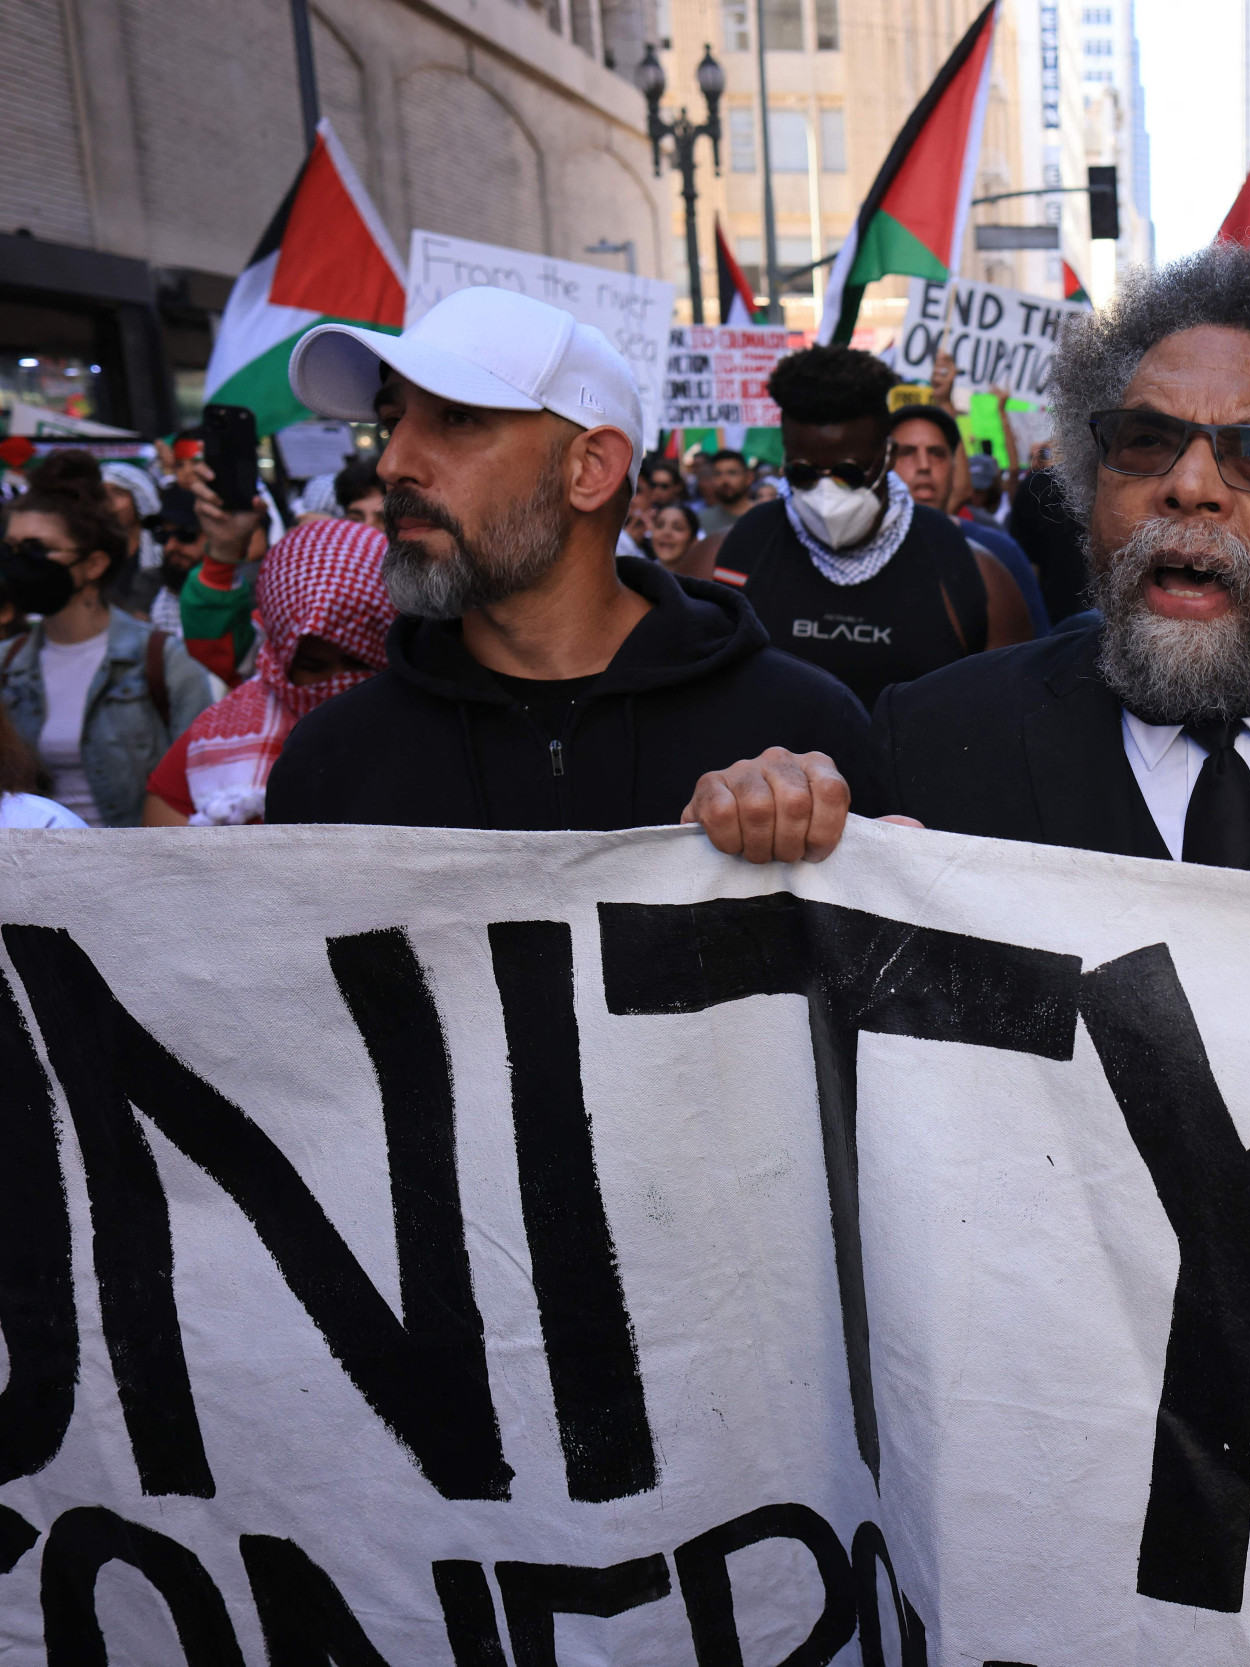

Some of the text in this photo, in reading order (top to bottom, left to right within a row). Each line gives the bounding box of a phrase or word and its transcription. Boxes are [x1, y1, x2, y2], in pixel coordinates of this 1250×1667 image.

[422, 237, 527, 294] From
[538, 262, 581, 303] the
[921, 282, 1004, 330] END
[793, 619, 892, 645] BLACK
